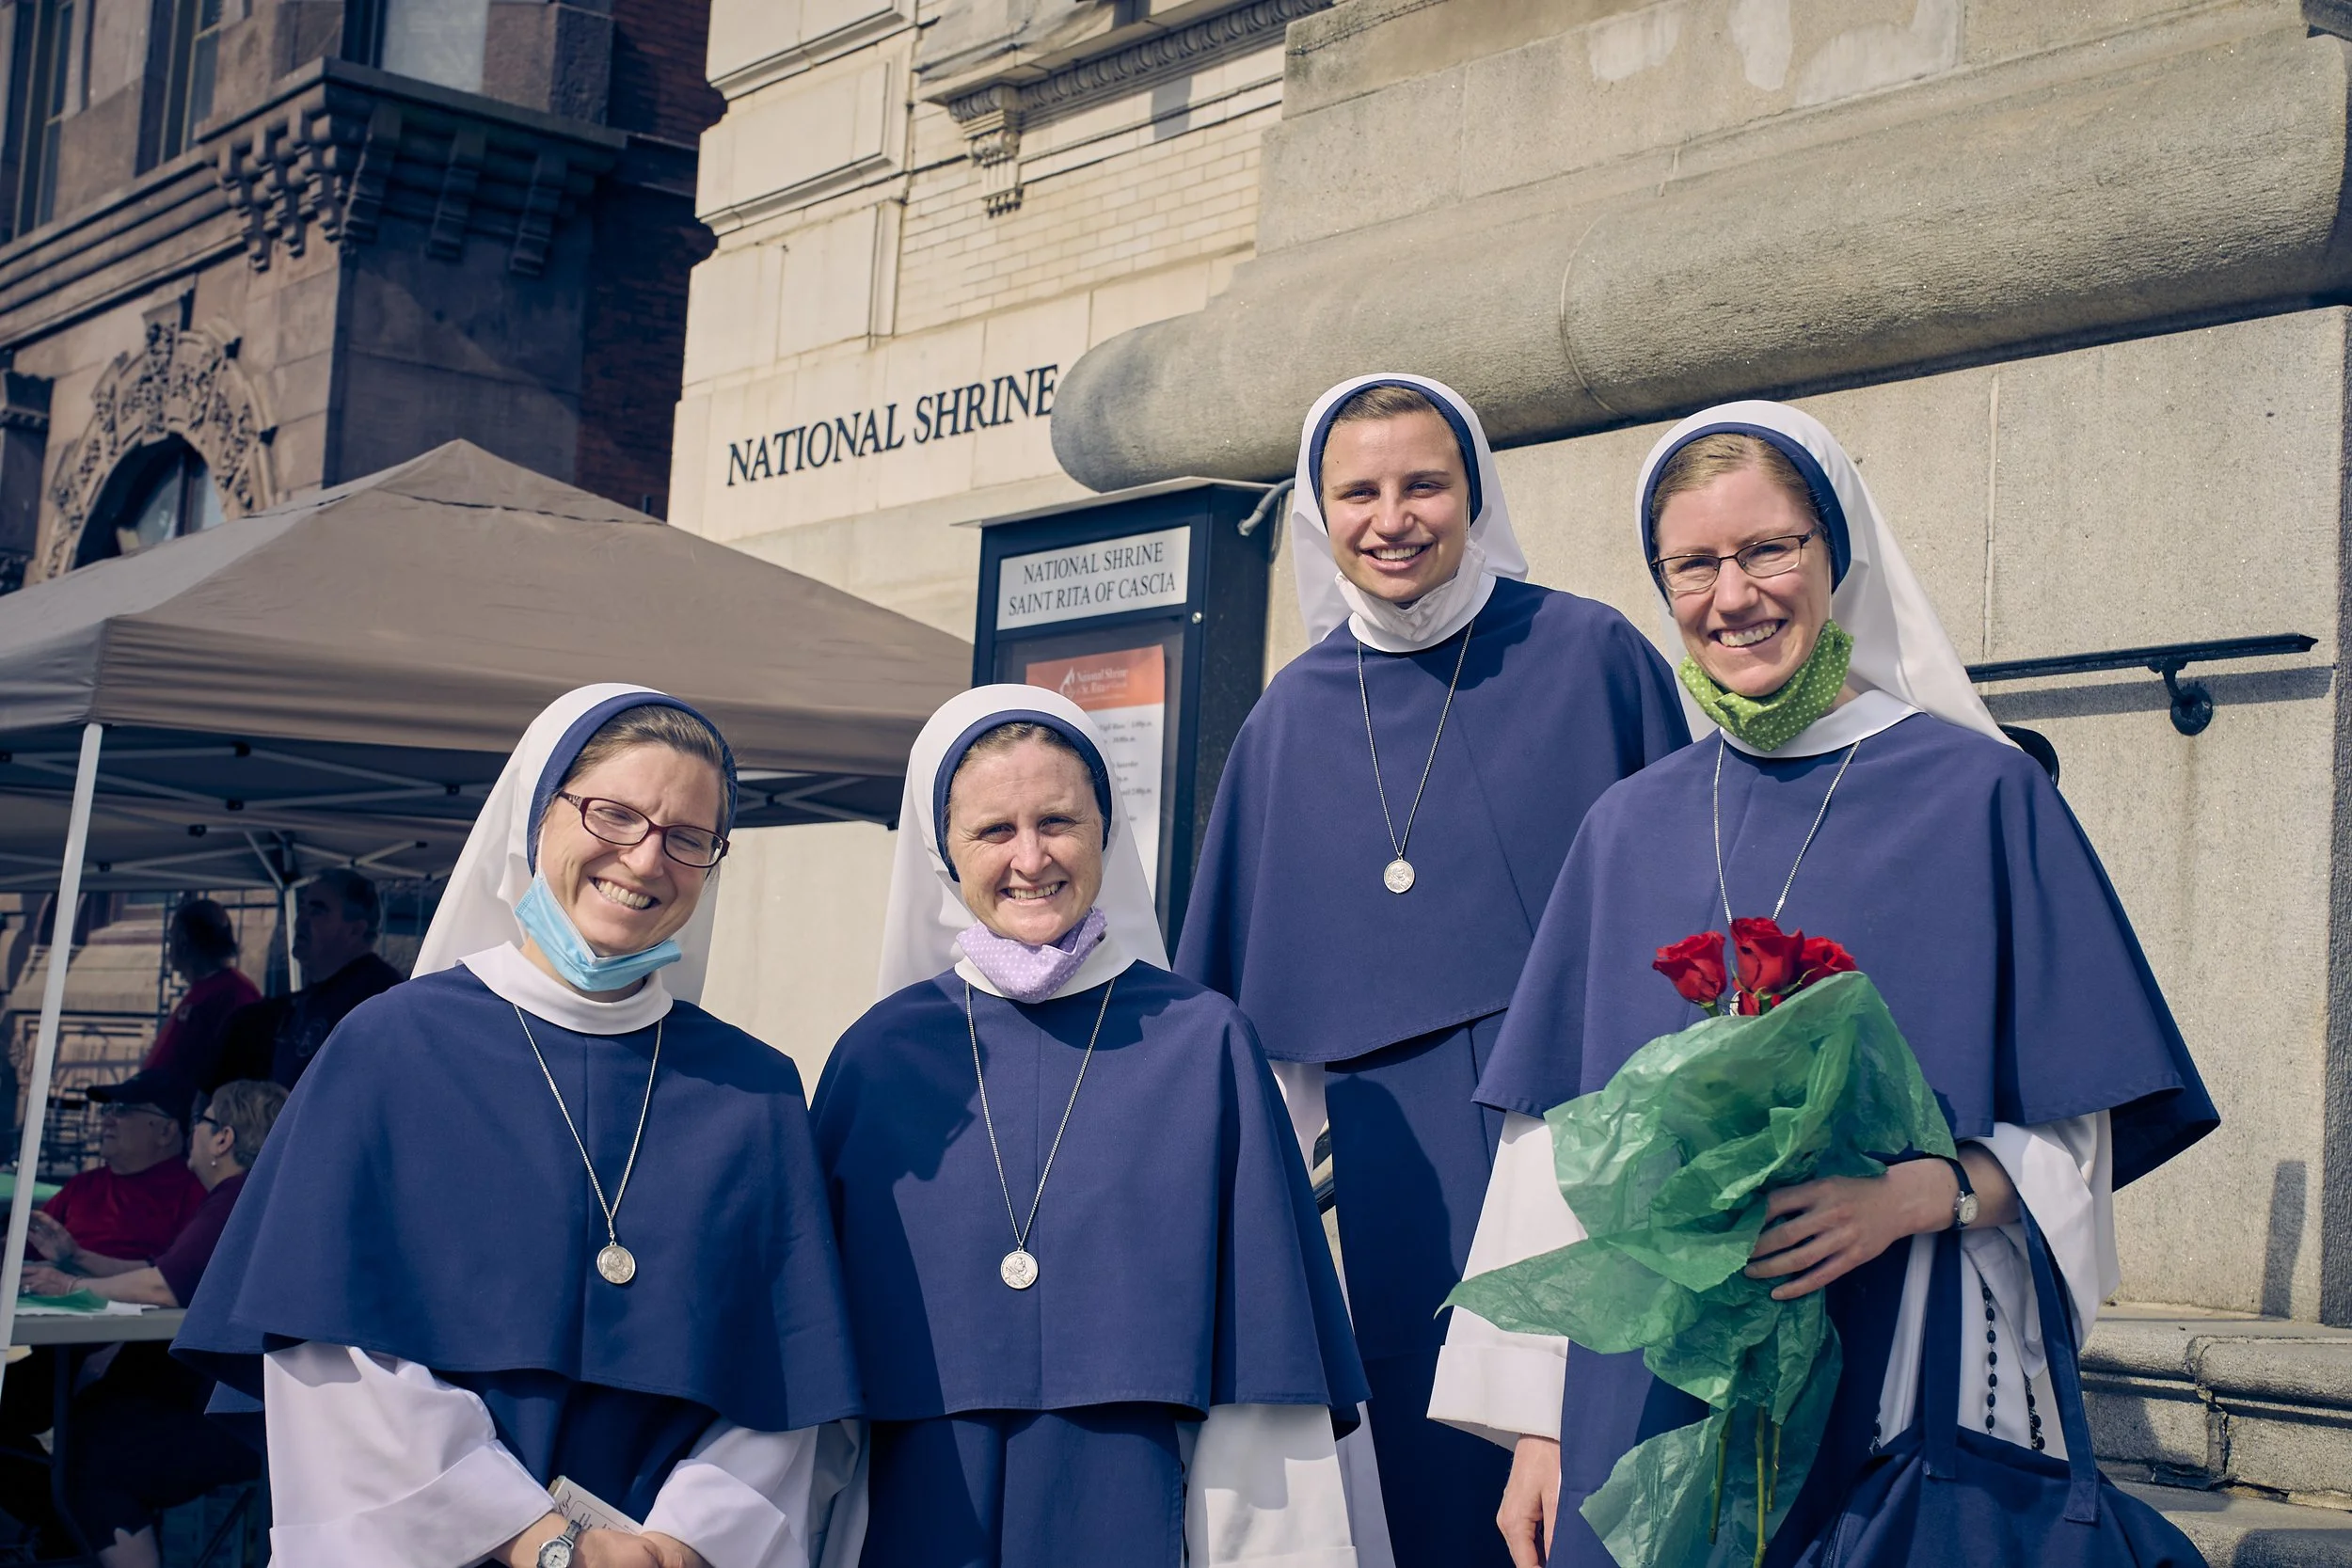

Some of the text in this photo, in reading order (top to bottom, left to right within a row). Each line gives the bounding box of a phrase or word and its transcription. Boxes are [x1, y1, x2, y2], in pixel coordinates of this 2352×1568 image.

[727, 364, 1058, 486] NATIONAL SHRINE
[1024, 542, 1164, 585] NATIONAL SHRINE
[1009, 572, 1175, 616] SAINT RITA OF CASCIA
